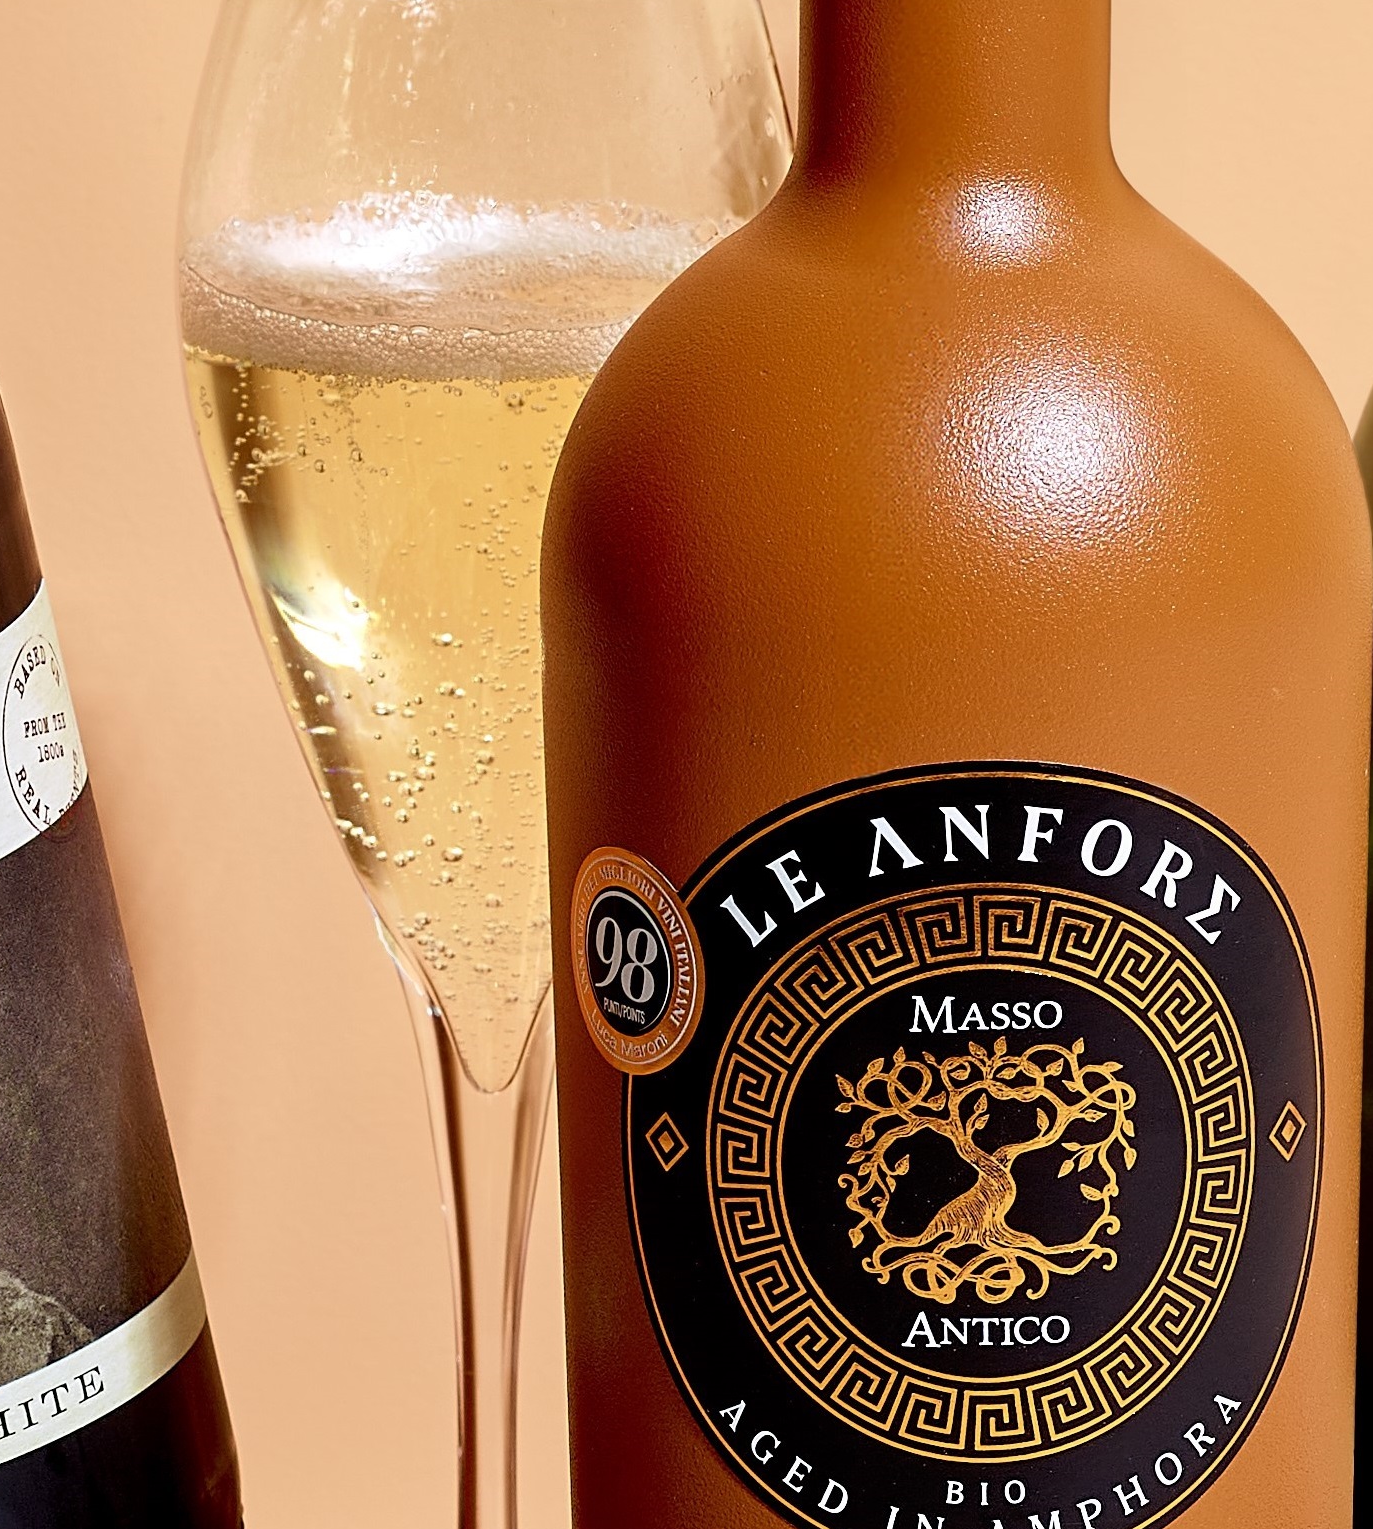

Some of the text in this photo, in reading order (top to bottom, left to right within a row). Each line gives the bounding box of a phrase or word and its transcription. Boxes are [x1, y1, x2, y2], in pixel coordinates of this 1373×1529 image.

[14, 645, 47, 699] BASED
[15, 765, 51, 826] REAL
[718, 848, 827, 949] LE
[594, 916, 658, 1004] 98
[598, 864, 655, 901] MIGLIORI
[656, 896, 683, 939] VINI
[670, 940, 690, 1027] ITALIANI
[591, 1008, 669, 1058] Luca Maroni
[603, 996, 646, 1025] PUNTI/POINTS
[908, 995, 1063, 1033] MASSO
[901, 1312, 1071, 1349] ANTICO
[718, 1398, 851, 1517] AGED
[945, 1478, 1027, 1506] BIO
